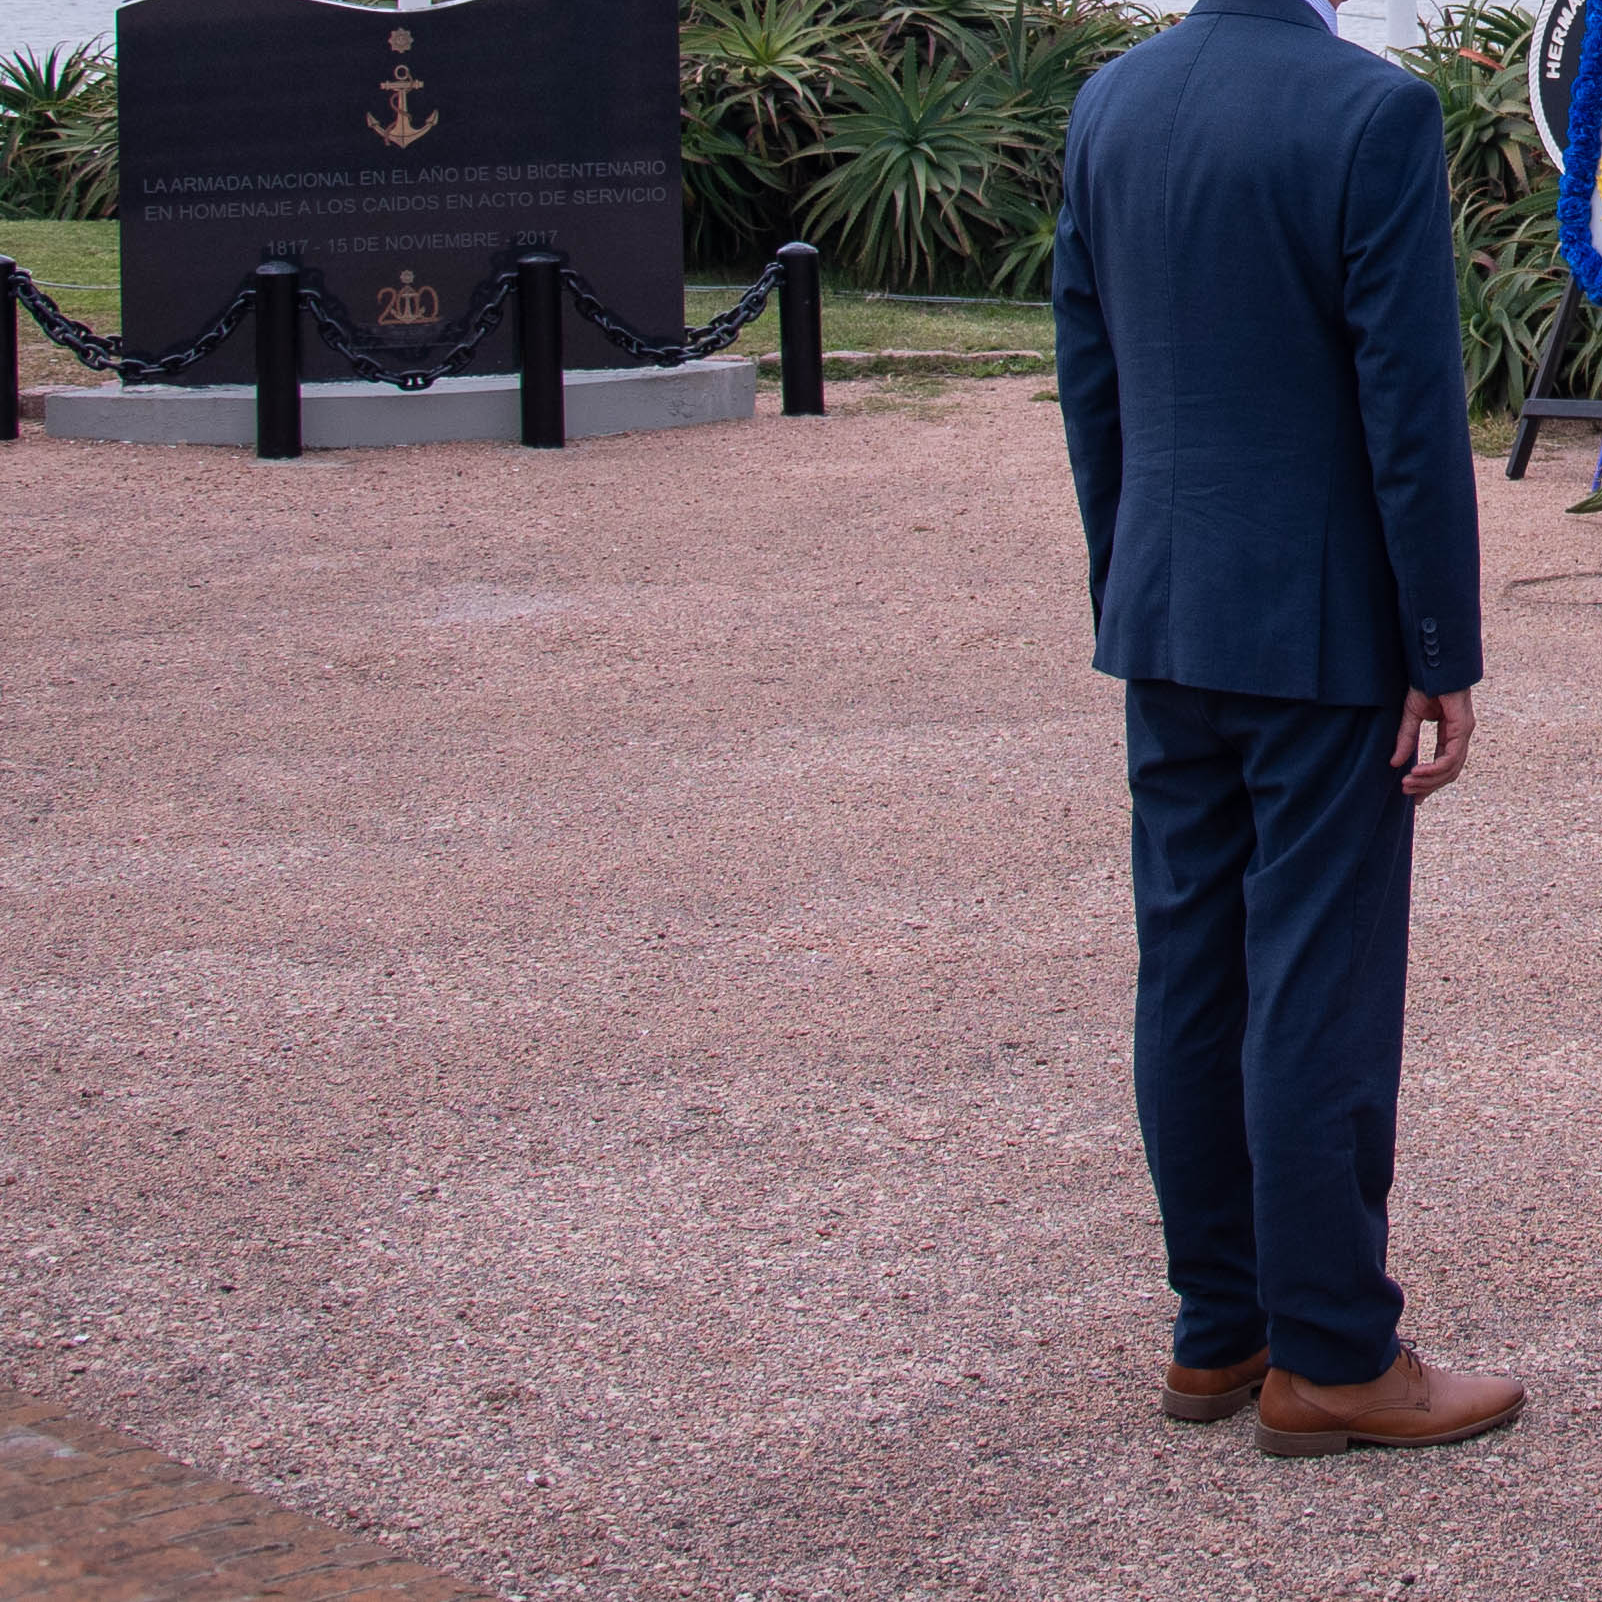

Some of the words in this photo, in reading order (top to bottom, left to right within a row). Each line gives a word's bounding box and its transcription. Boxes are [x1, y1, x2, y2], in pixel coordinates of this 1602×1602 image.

[143, 178, 168, 194] LA
[170, 175, 252, 194] ARMADA
[257, 172, 355, 191] NACIONAL
[360, 170, 385, 186] EN
[391, 169, 414, 185] EL
[418, 165, 459, 183] AÑO
[464, 165, 490, 182] DE
[495, 164, 521, 181] SU
[527, 160, 667, 179] BICENTENARIO
[144, 205, 172, 221] EN
[180, 201, 292, 219] HOMENAJE
[297, 200, 312, 215] A
[316, 198, 356, 215] LOS
[446, 193, 473, 210] EN
[477, 191, 534, 209] ACTO
[539, 190, 567, 206] DE
[572, 186, 667, 206] SERVICIO
[267, 239, 309, 256] 1817
[329, 238, 348, 254] 15
[353, 235, 380, 253] DE
[385, 230, 501, 251] NOVIEMBRE
[516, 230, 558, 246] 2017
